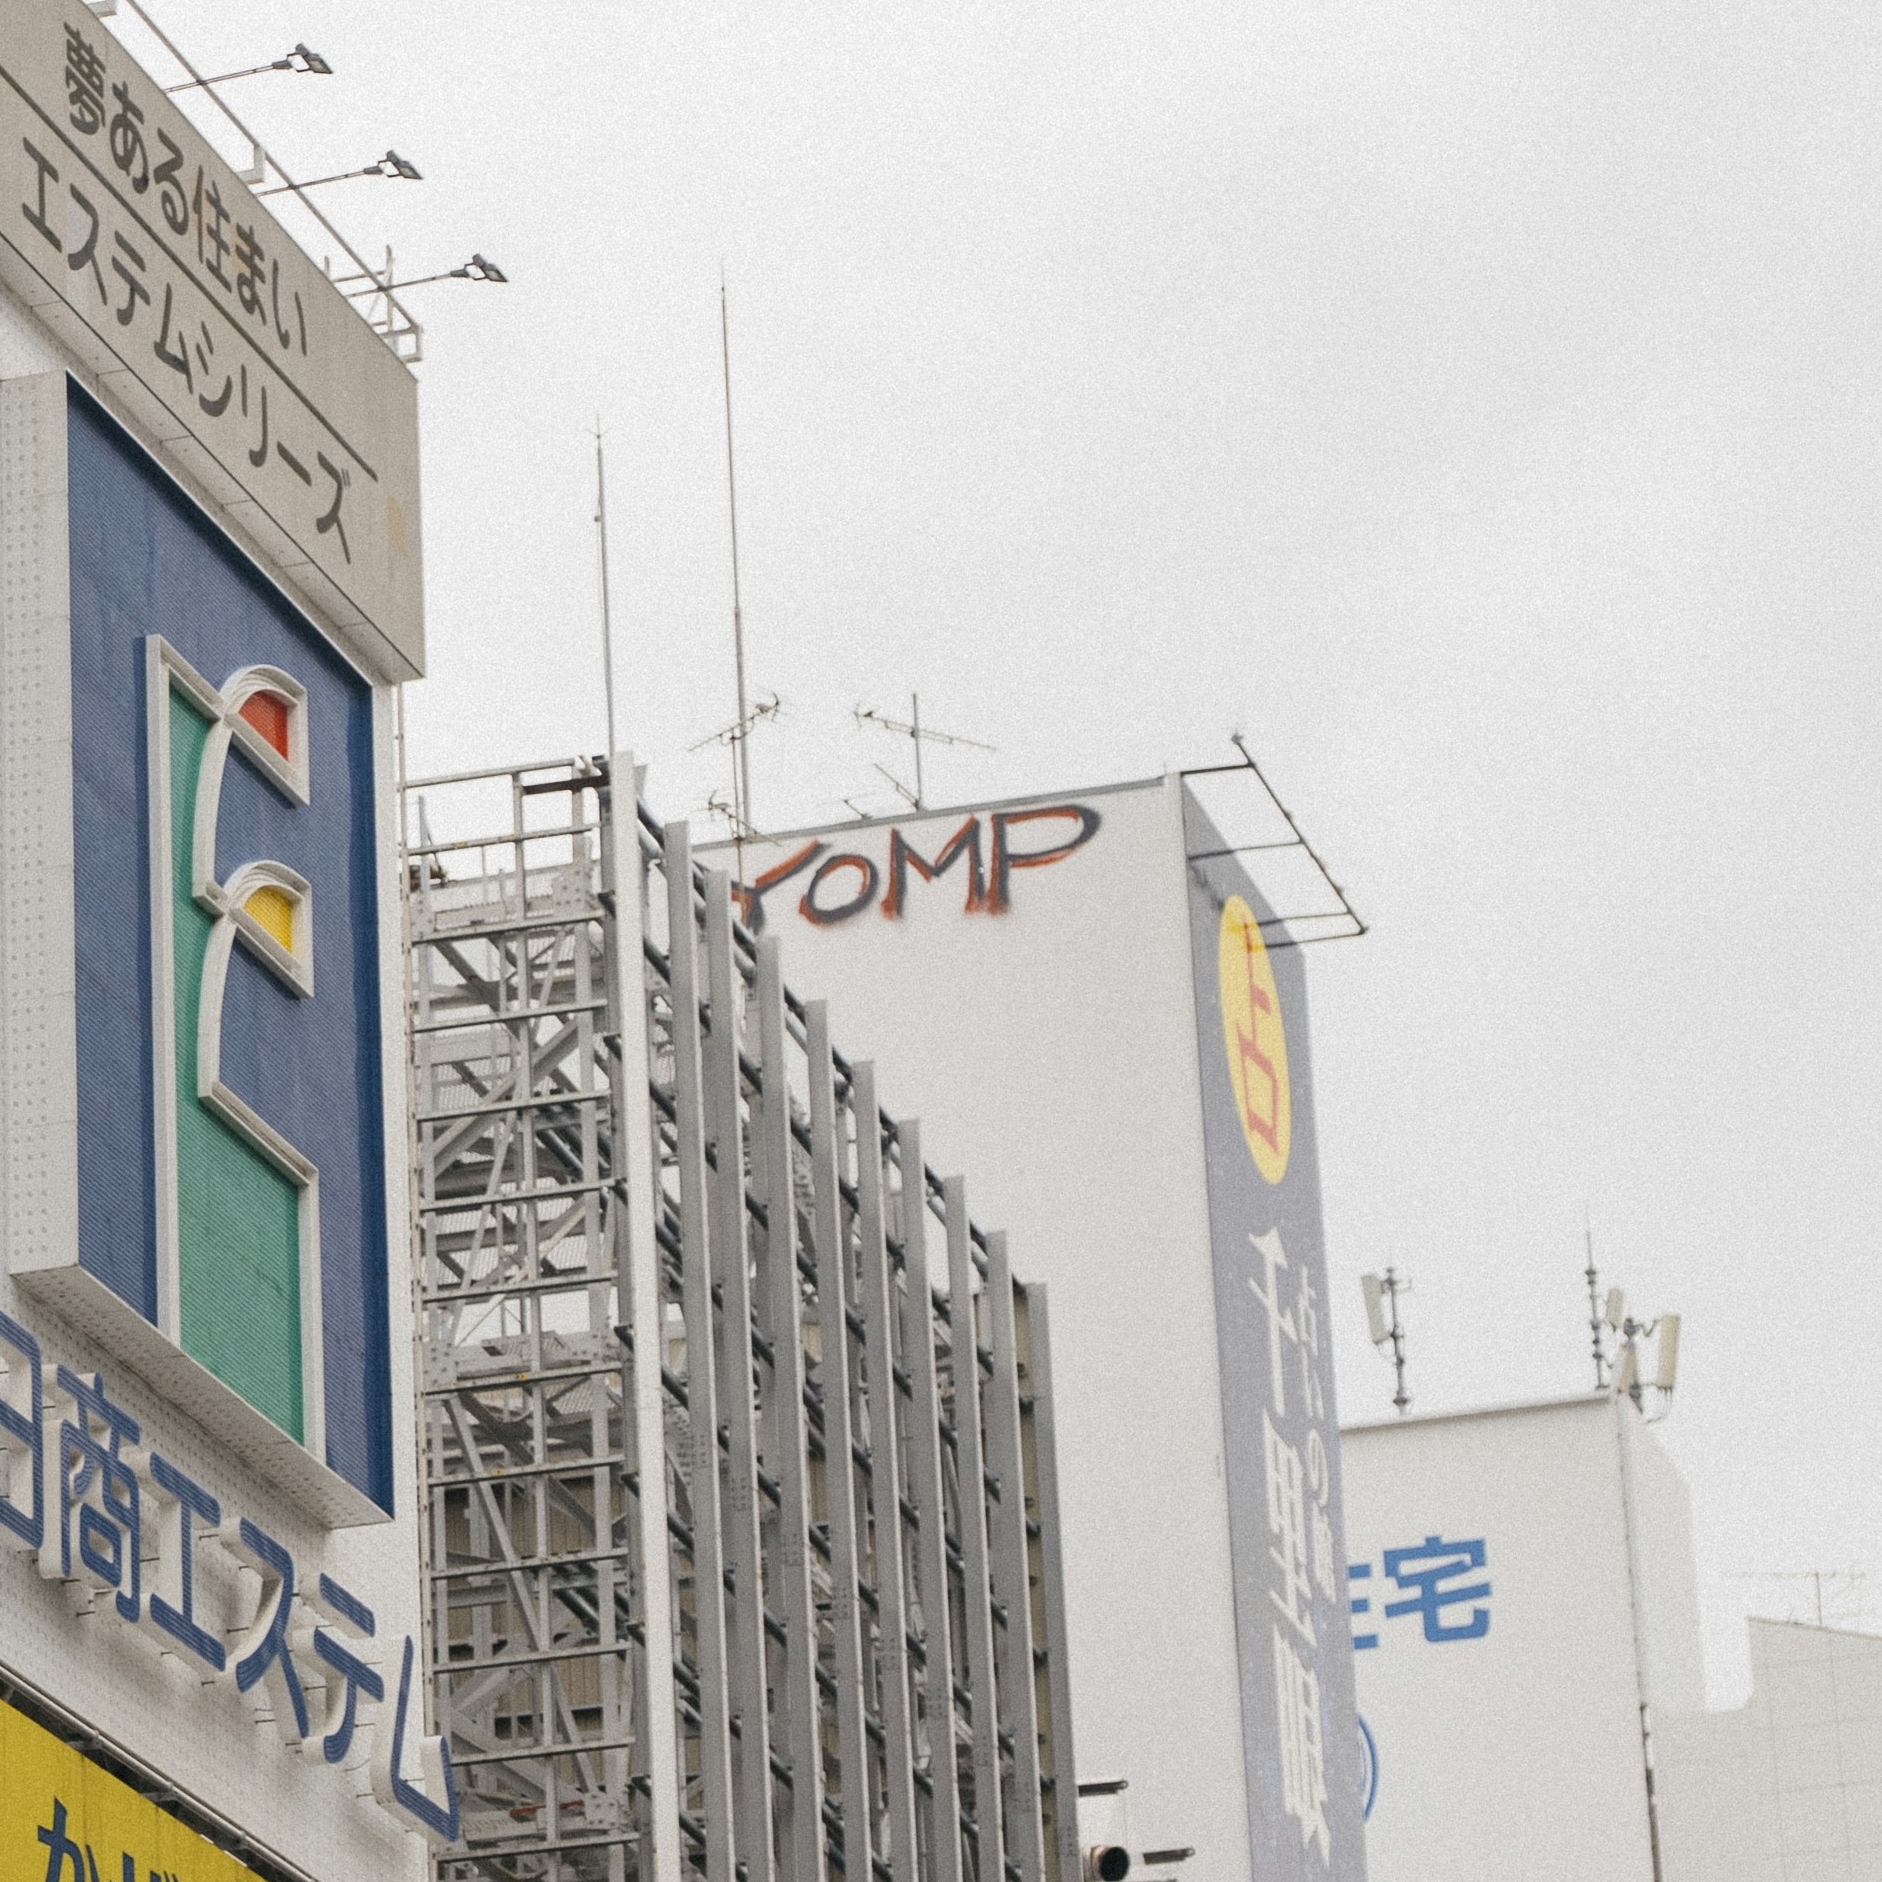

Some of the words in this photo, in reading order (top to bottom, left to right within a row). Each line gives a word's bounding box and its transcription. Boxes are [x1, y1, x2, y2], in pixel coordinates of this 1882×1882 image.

[21, 136, 354, 566] エステムシリーズ
[63, 20, 310, 358] 夢ある住まい
[1236, 913, 1280, 1156] 占
[1247, 1226, 1332, 1868] 千里眼
